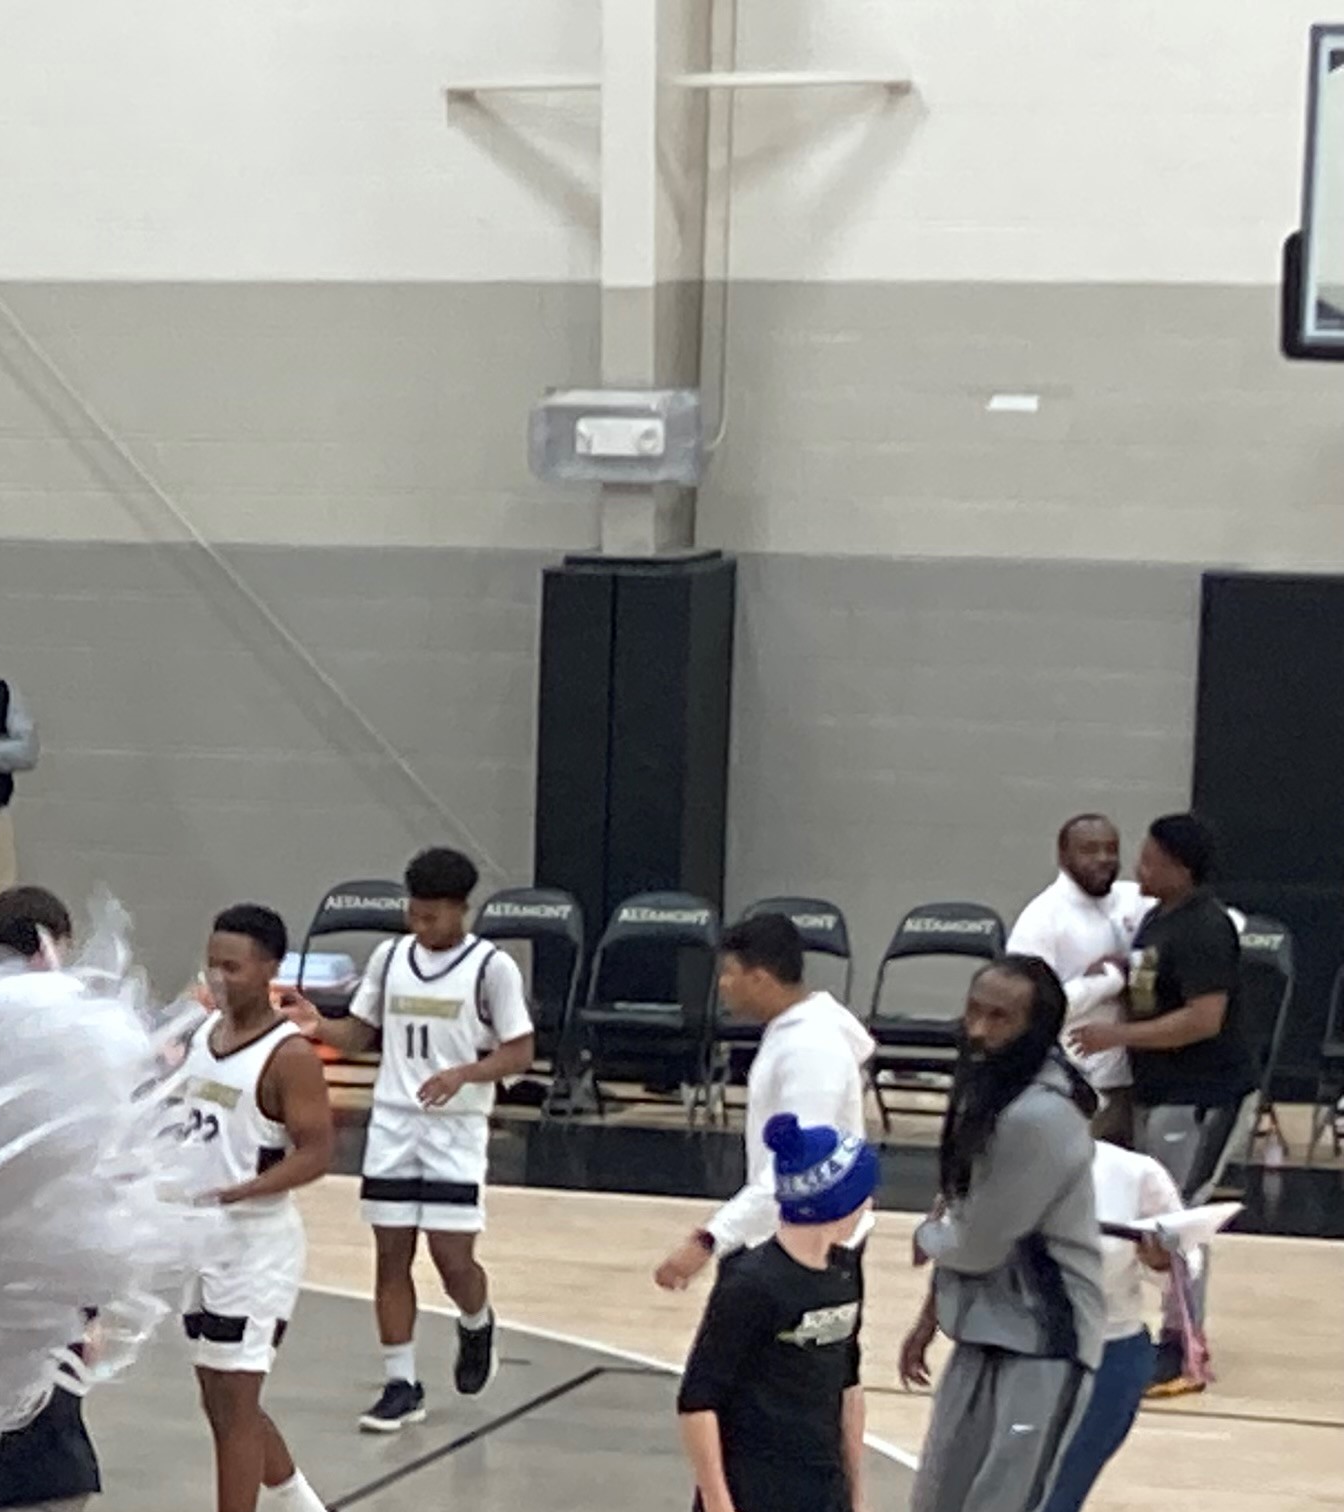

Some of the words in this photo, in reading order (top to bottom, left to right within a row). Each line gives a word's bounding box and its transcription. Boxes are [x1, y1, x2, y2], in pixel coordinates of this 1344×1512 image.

[483, 902, 573, 920] ALTAMONT
[618, 907, 710, 926] ALTAMONT
[903, 917, 997, 935] ALTAMONT
[406, 1022, 429, 1059] 11
